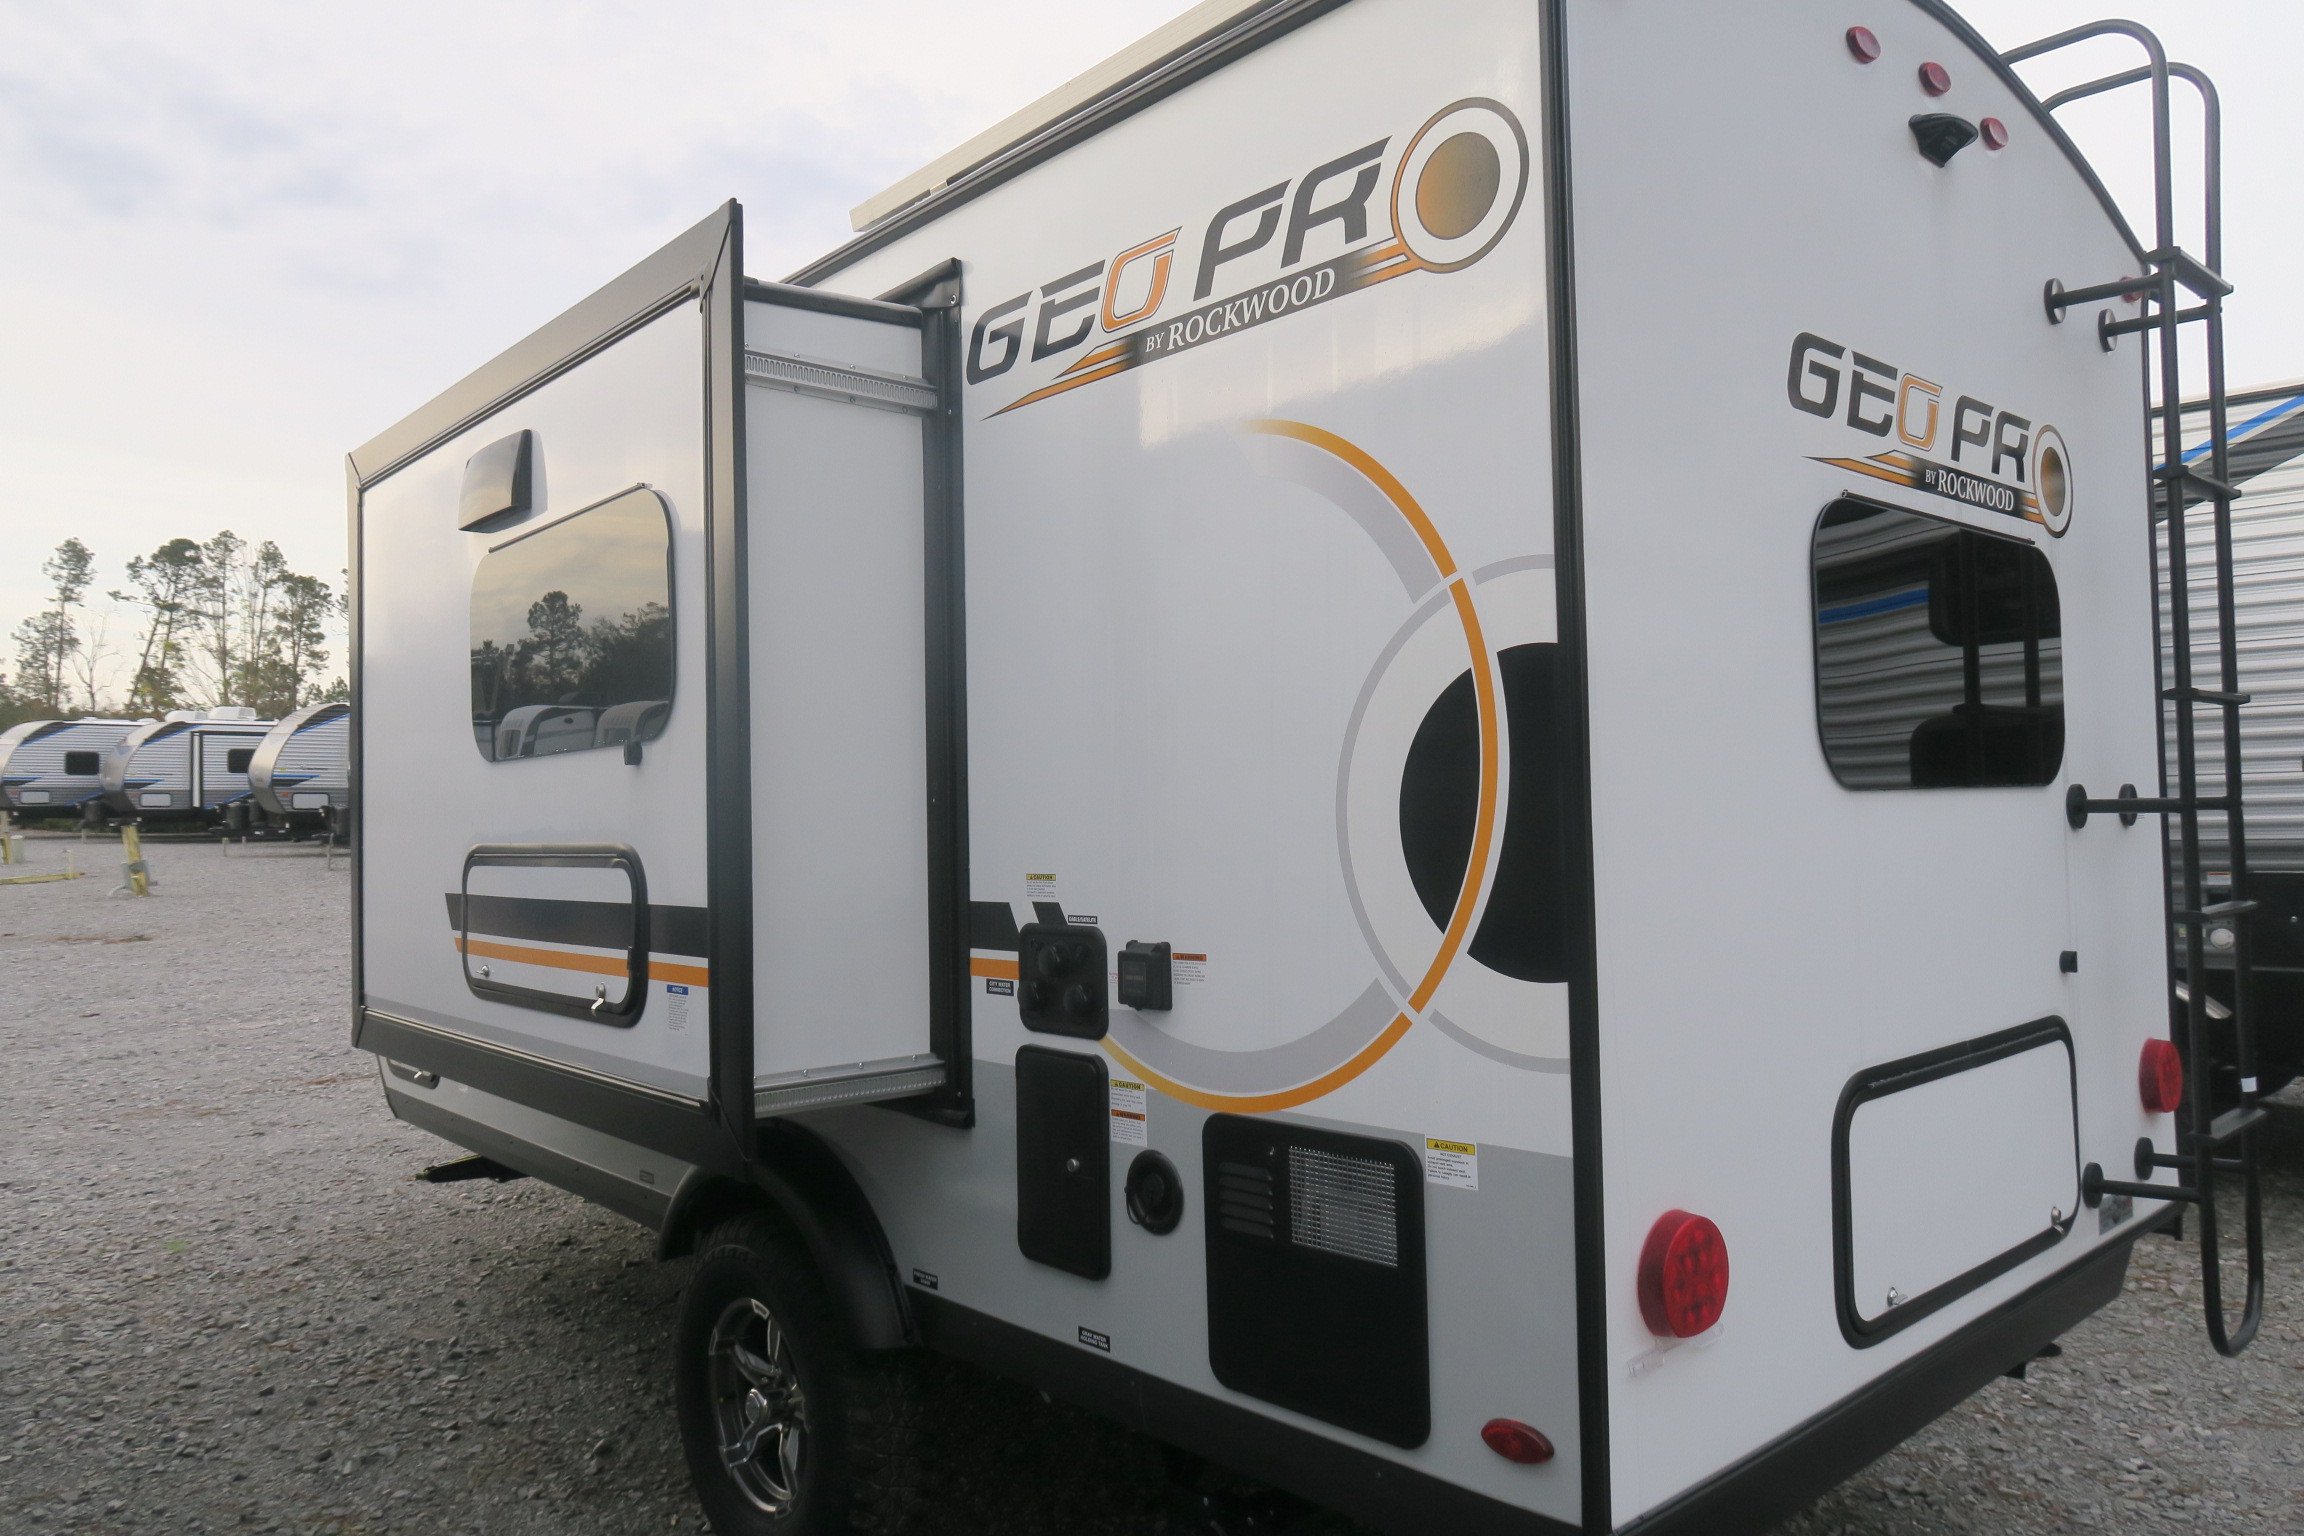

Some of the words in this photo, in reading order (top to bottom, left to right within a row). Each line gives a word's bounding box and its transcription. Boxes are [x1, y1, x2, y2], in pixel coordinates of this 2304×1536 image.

[966, 226, 1182, 386] GEO
[1193, 97, 1530, 301] PRO
[1146, 333, 1164, 353] BY
[1167, 267, 1336, 352] ROCKWOOD
[1787, 331, 1943, 452] GEO
[1951, 394, 2074, 539] PRO
[1925, 469, 1937, 484] BY
[1938, 469, 2015, 512] ROCKWOOD
[1119, 1082, 1141, 1090] CAUTION
[1440, 1143, 1468, 1152] CAUTION
